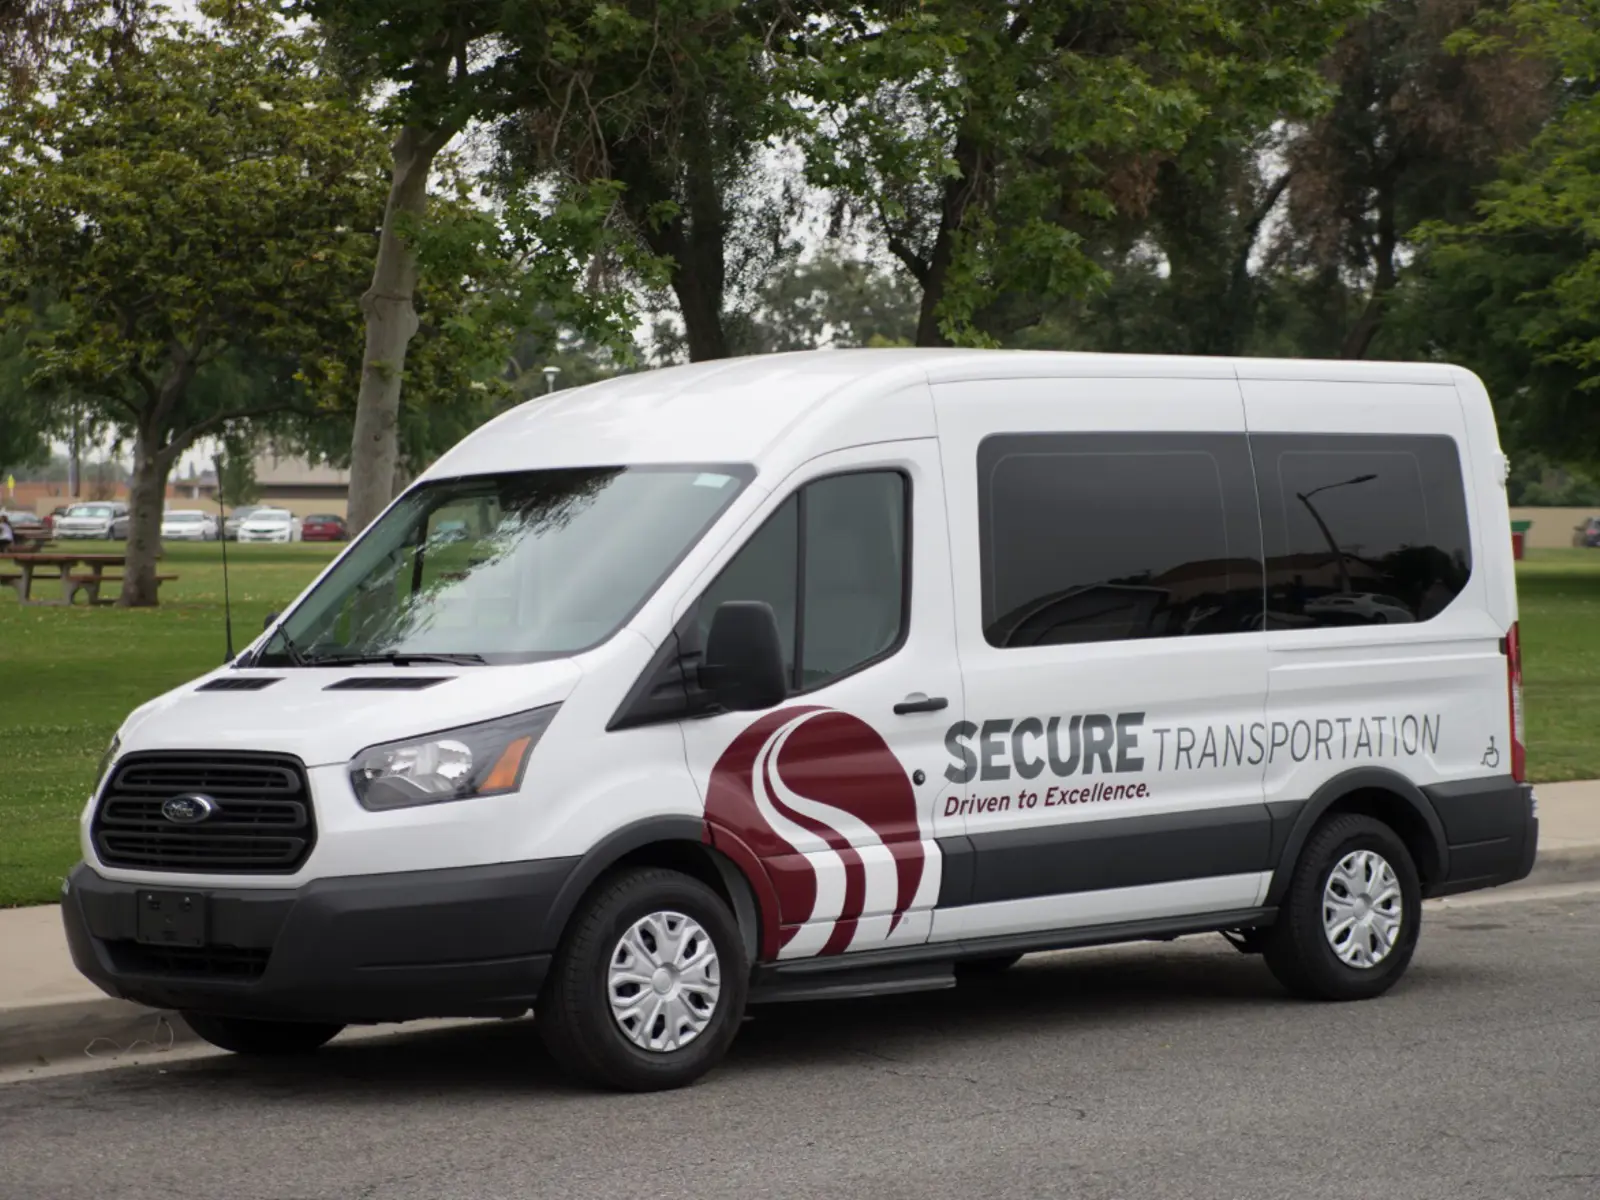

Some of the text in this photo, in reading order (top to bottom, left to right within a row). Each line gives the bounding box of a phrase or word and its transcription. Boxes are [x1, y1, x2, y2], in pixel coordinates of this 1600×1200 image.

[944, 712, 1440, 784] SECURE TRANSPORTATION
[944, 782, 1151, 817] Driven to Excellence.
